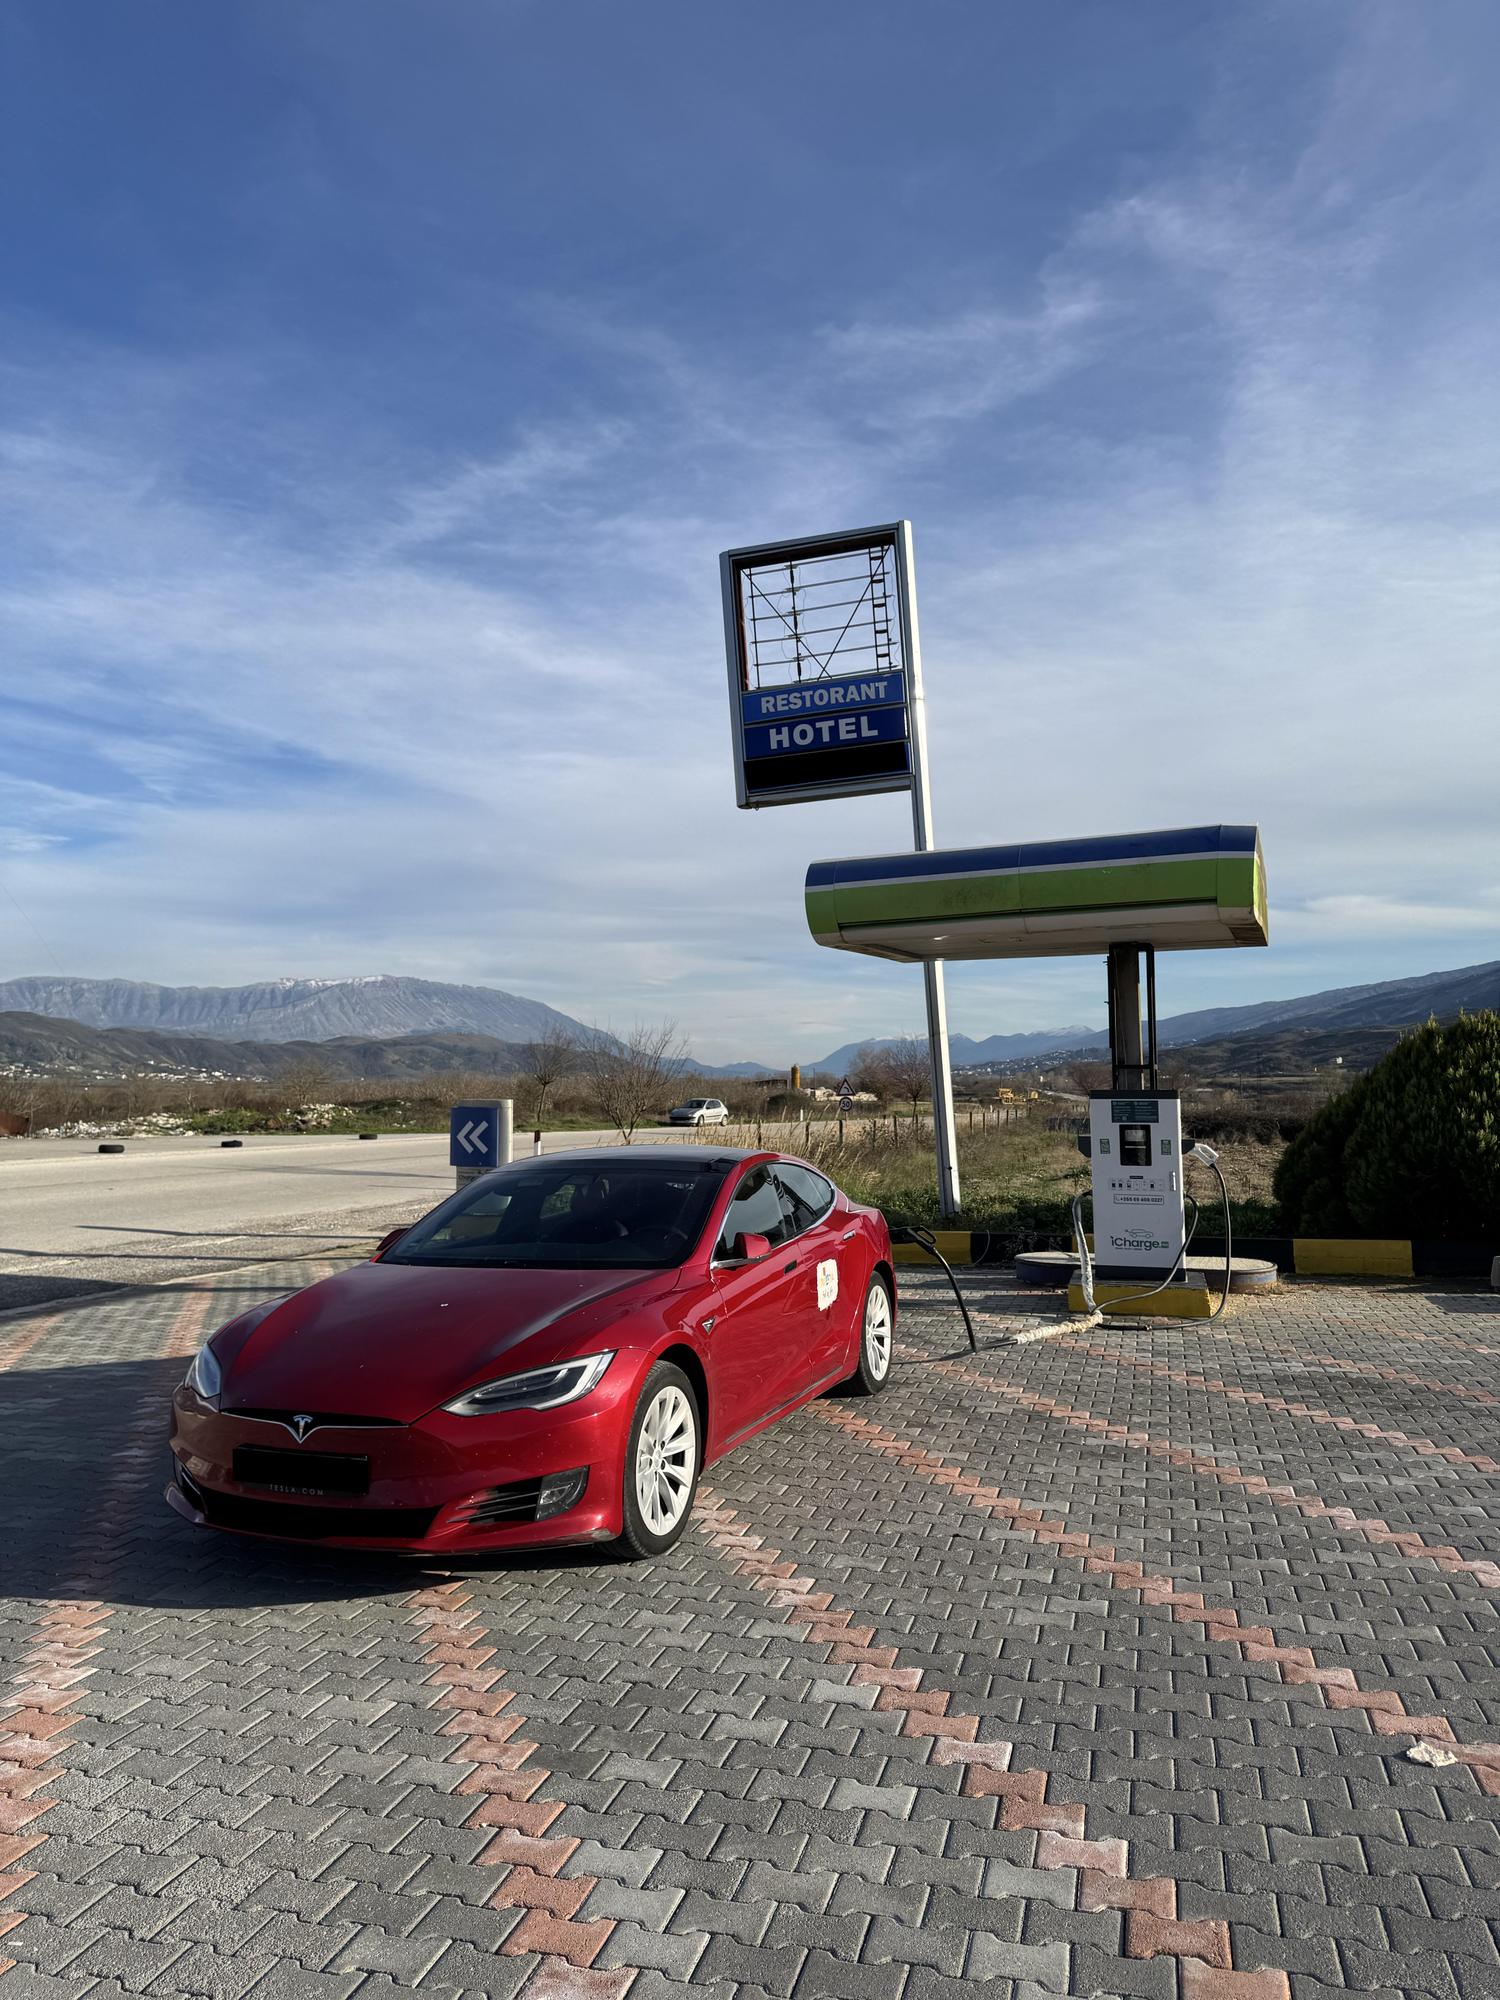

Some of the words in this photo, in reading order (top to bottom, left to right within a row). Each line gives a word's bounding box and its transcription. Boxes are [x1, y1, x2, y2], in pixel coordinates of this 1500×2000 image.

[761, 681, 888, 714] RESTORANT
[769, 716, 879, 750] HOTEL
[842, 1100, 850, 1108] 50
[269, 1484, 324, 1496] TESLA.COM
